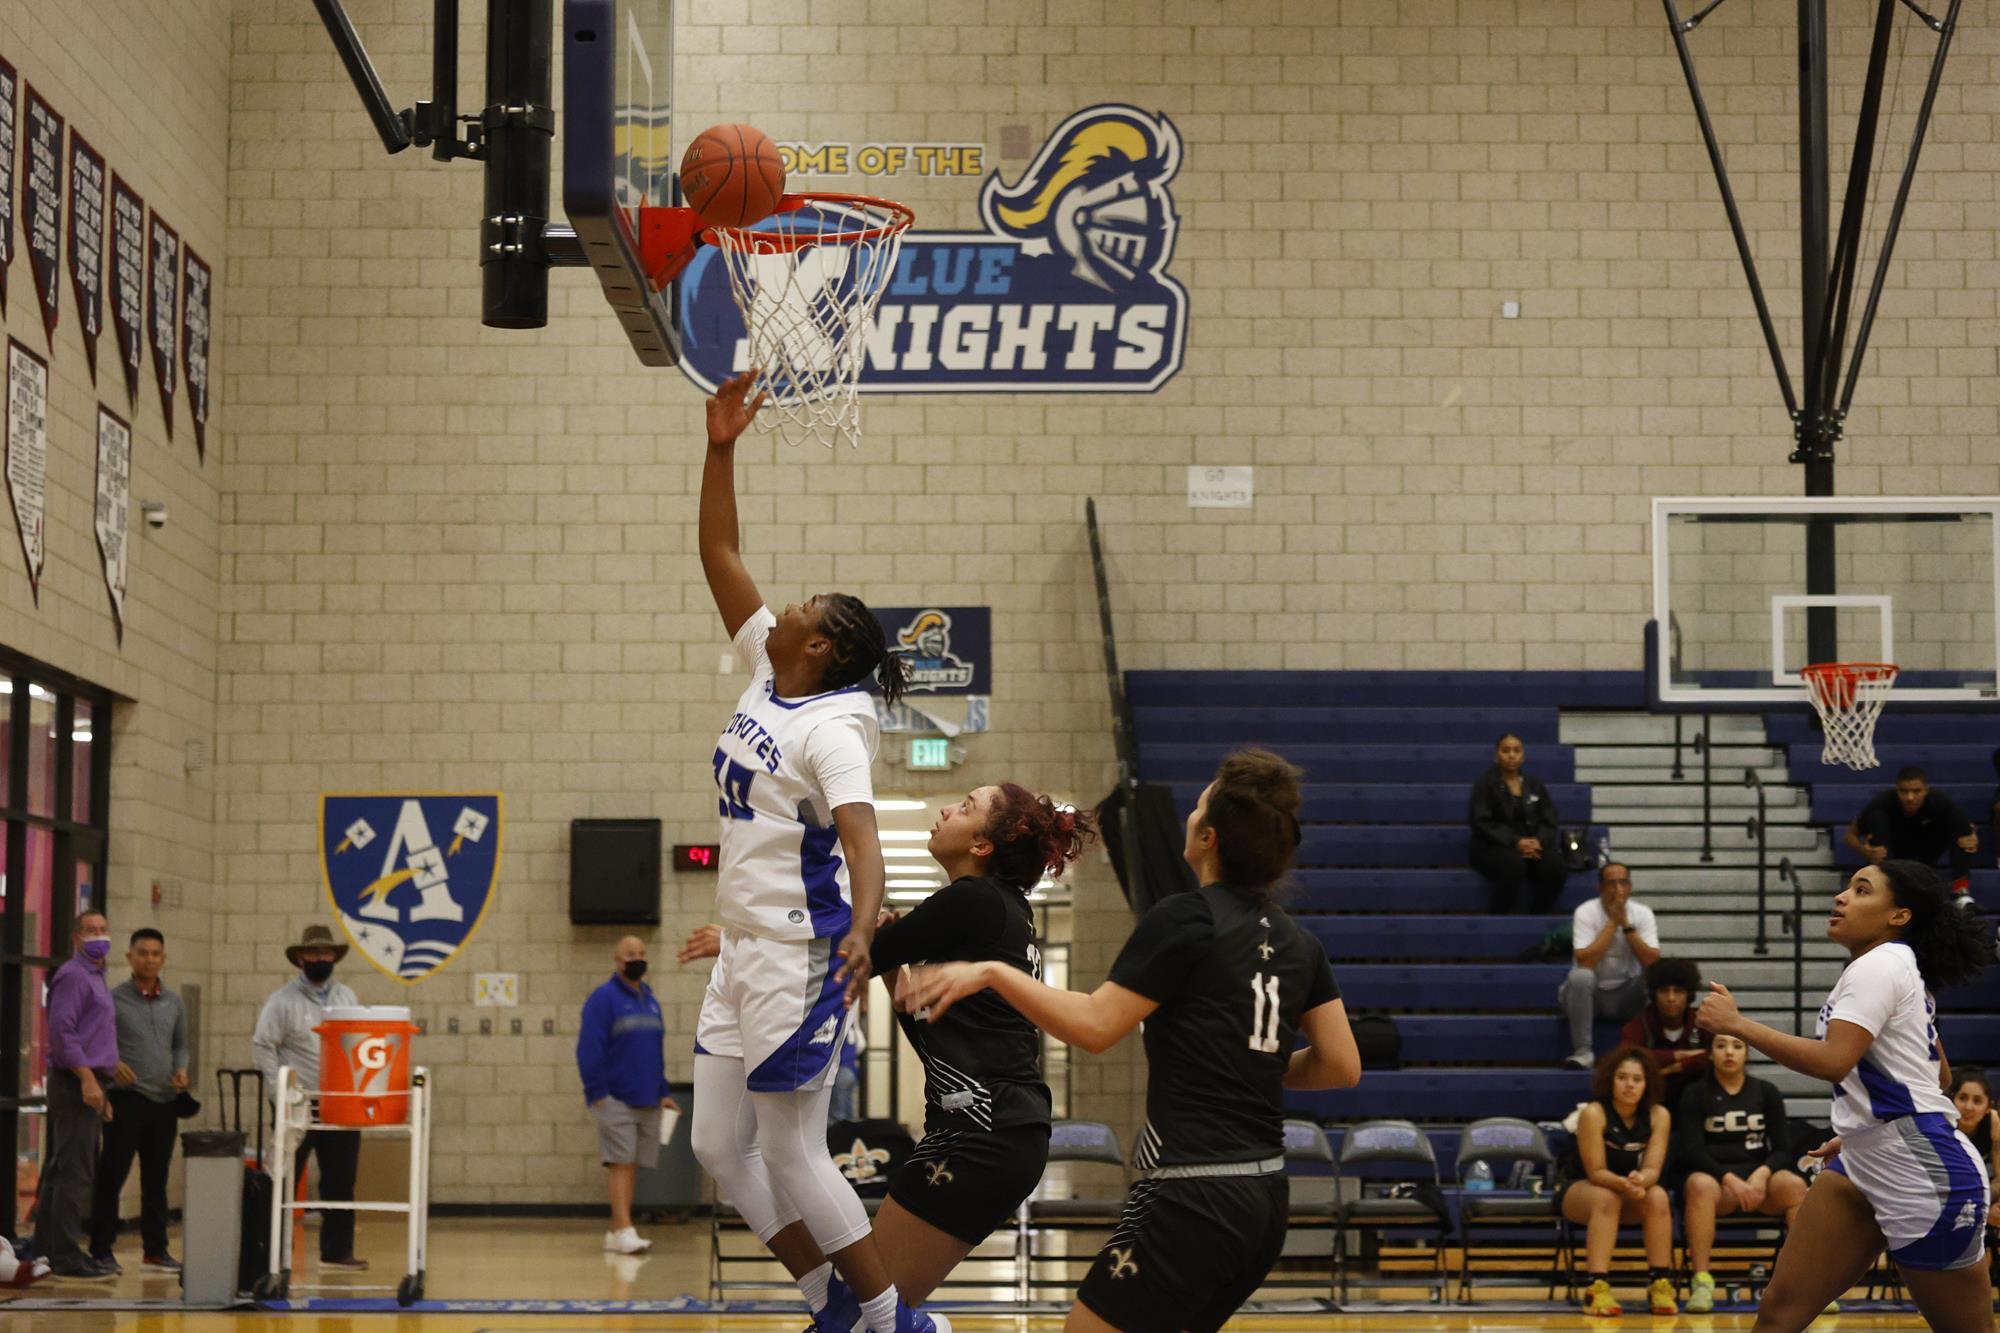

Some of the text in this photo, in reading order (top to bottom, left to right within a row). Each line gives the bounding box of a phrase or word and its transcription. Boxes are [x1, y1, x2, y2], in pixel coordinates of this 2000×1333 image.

[776, 145, 983, 176] OME OF THE
[904, 665, 968, 683] NIGHTS
[722, 713, 782, 774] OYOTES
[1248, 971, 1281, 1053] 11
[358, 1037, 386, 1070] G
[1704, 1110, 1766, 1133] CCC
